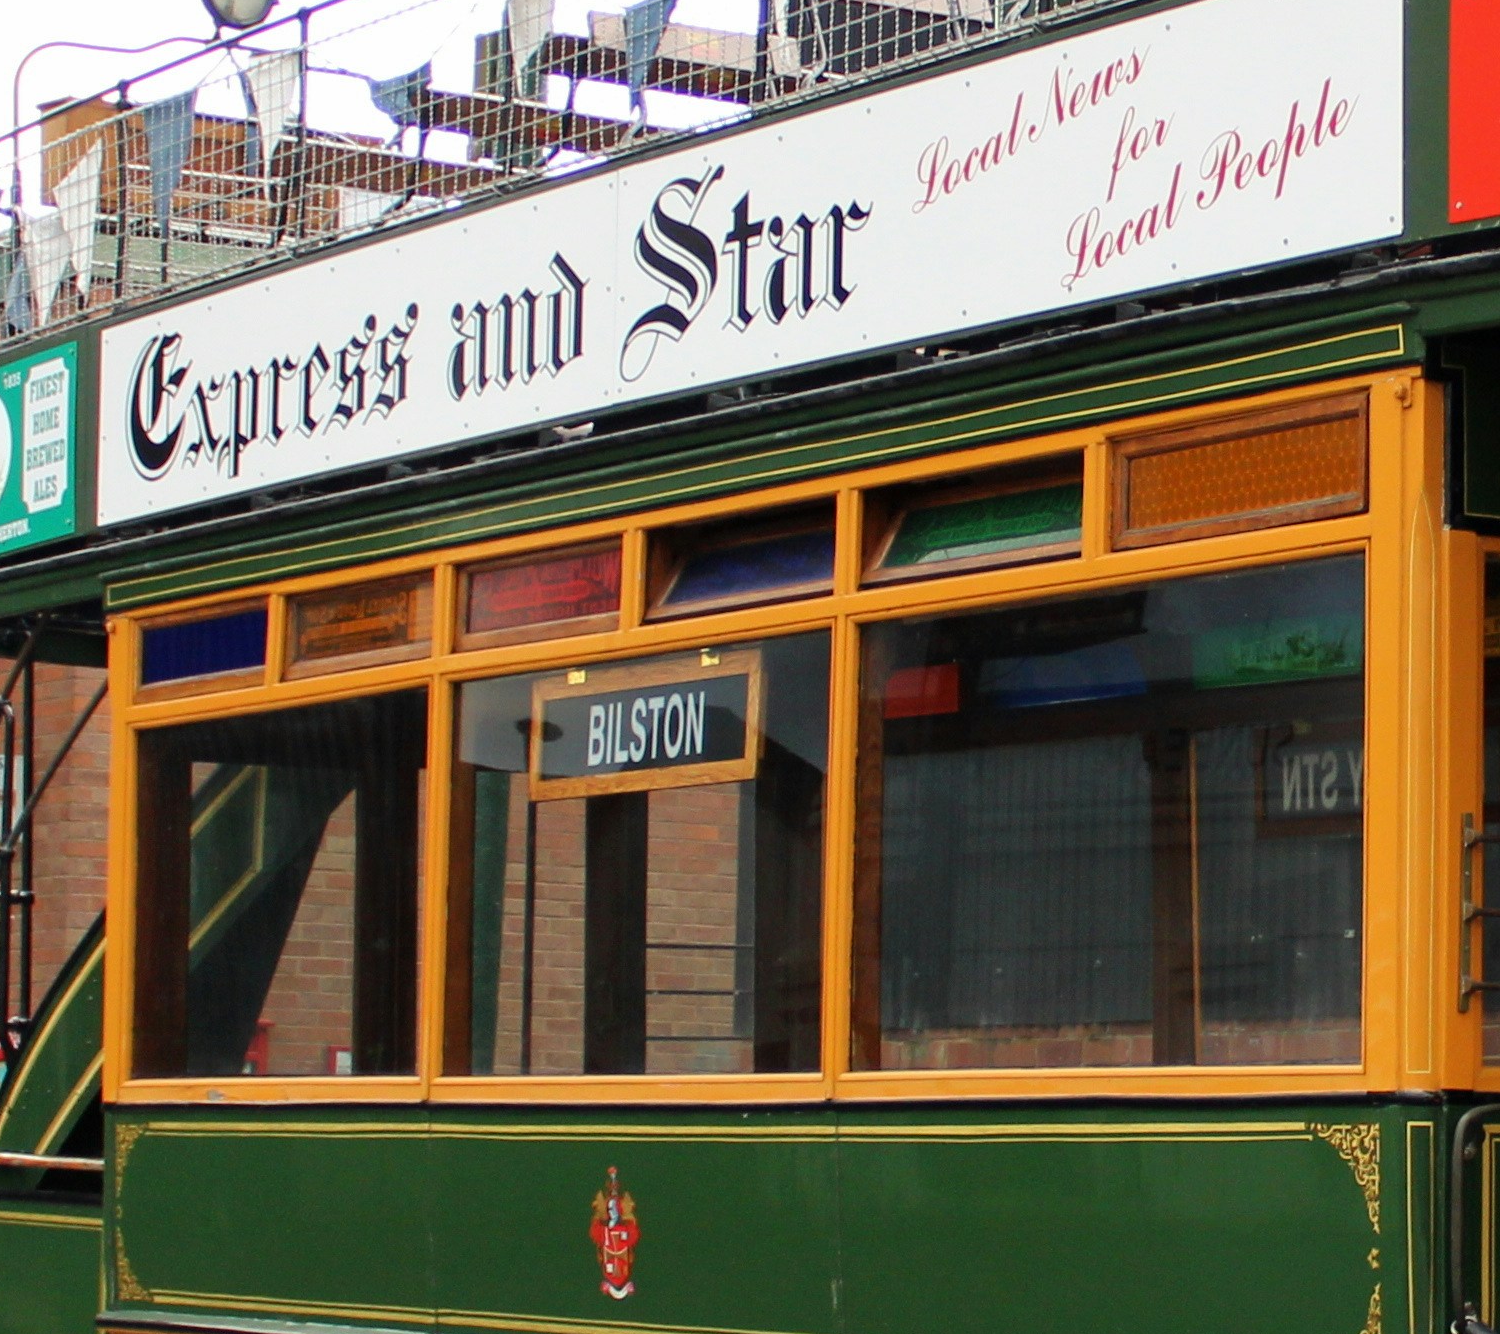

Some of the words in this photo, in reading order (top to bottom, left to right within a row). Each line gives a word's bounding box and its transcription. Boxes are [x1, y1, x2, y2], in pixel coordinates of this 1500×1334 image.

[912, 91, 1028, 214] Local
[1028, 44, 1150, 142] News
[1107, 105, 1175, 203] for
[1060, 162, 1187, 288] Local
[1196, 76, 1359, 210] People
[448, 252, 589, 401] and
[620, 165, 874, 382] Star
[30, 371, 65, 403] FINEST
[33, 406, 60, 435] HOME
[27, 438, 65, 471] BREWED
[33, 475, 58, 503] ALES
[587, 691, 705, 766] BILSTON
